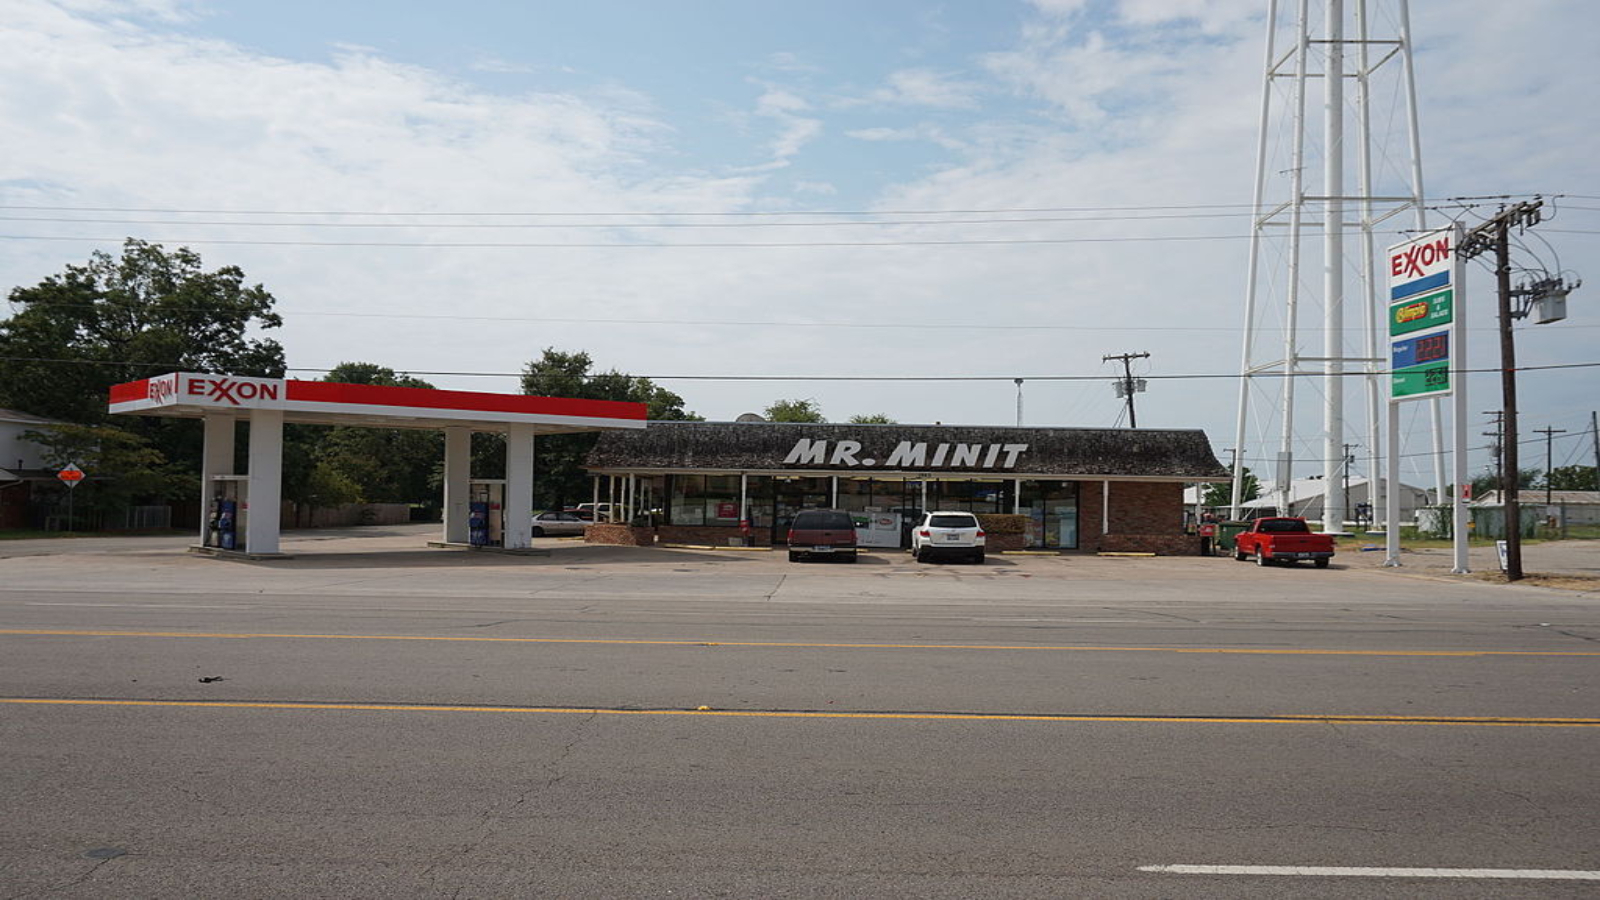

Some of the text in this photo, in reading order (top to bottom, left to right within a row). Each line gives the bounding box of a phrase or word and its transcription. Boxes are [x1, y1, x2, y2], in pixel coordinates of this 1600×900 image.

[1392, 237, 1449, 278] EXXON
[150, 379, 173, 405] EXXON
[187, 378, 278, 405] EXXON
[783, 438, 1029, 469] MR. MINIT
